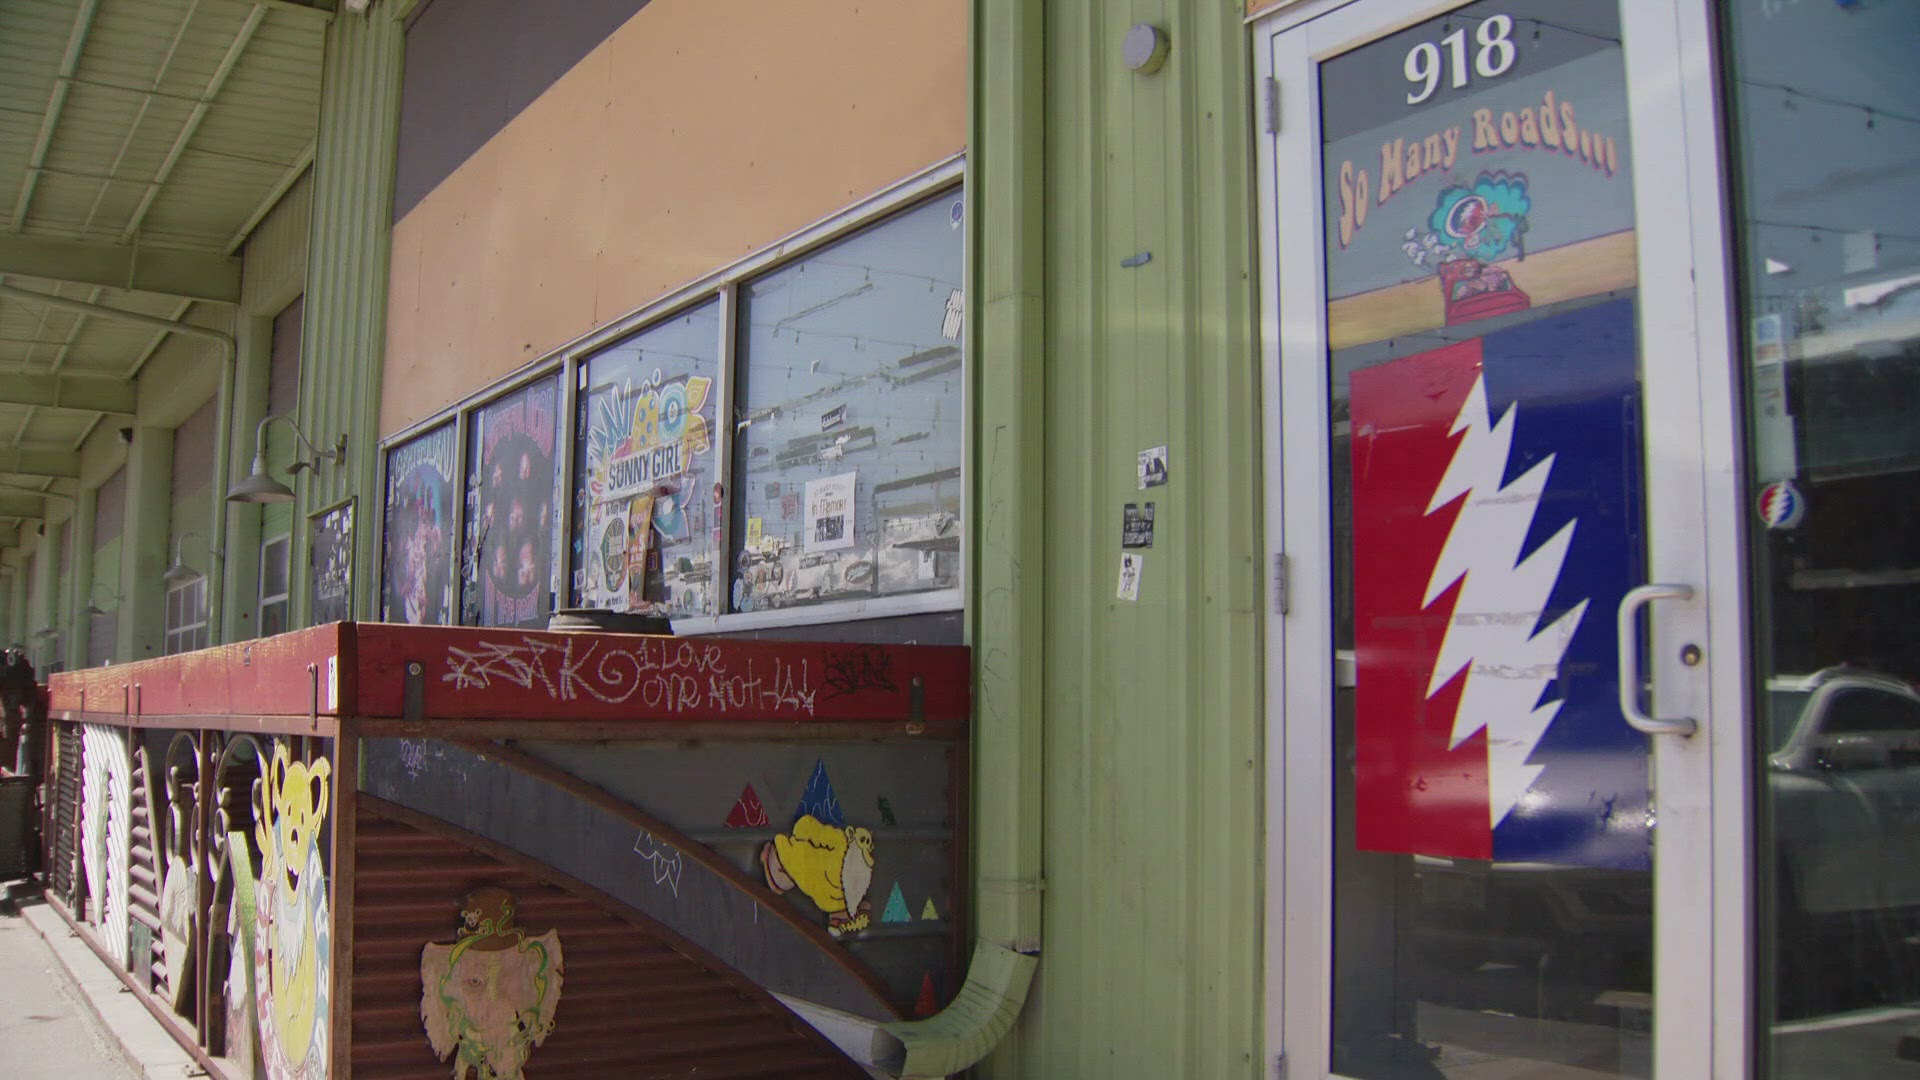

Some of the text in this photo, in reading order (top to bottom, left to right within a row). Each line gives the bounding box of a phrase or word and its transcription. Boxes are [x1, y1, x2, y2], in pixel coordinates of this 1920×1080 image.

[1403, 14, 1517, 105] 918
[1338, 160, 1369, 250] So
[1377, 126, 1460, 207] Many
[608, 453, 650, 491] SUNNY
[652, 443, 681, 478] GIRL
